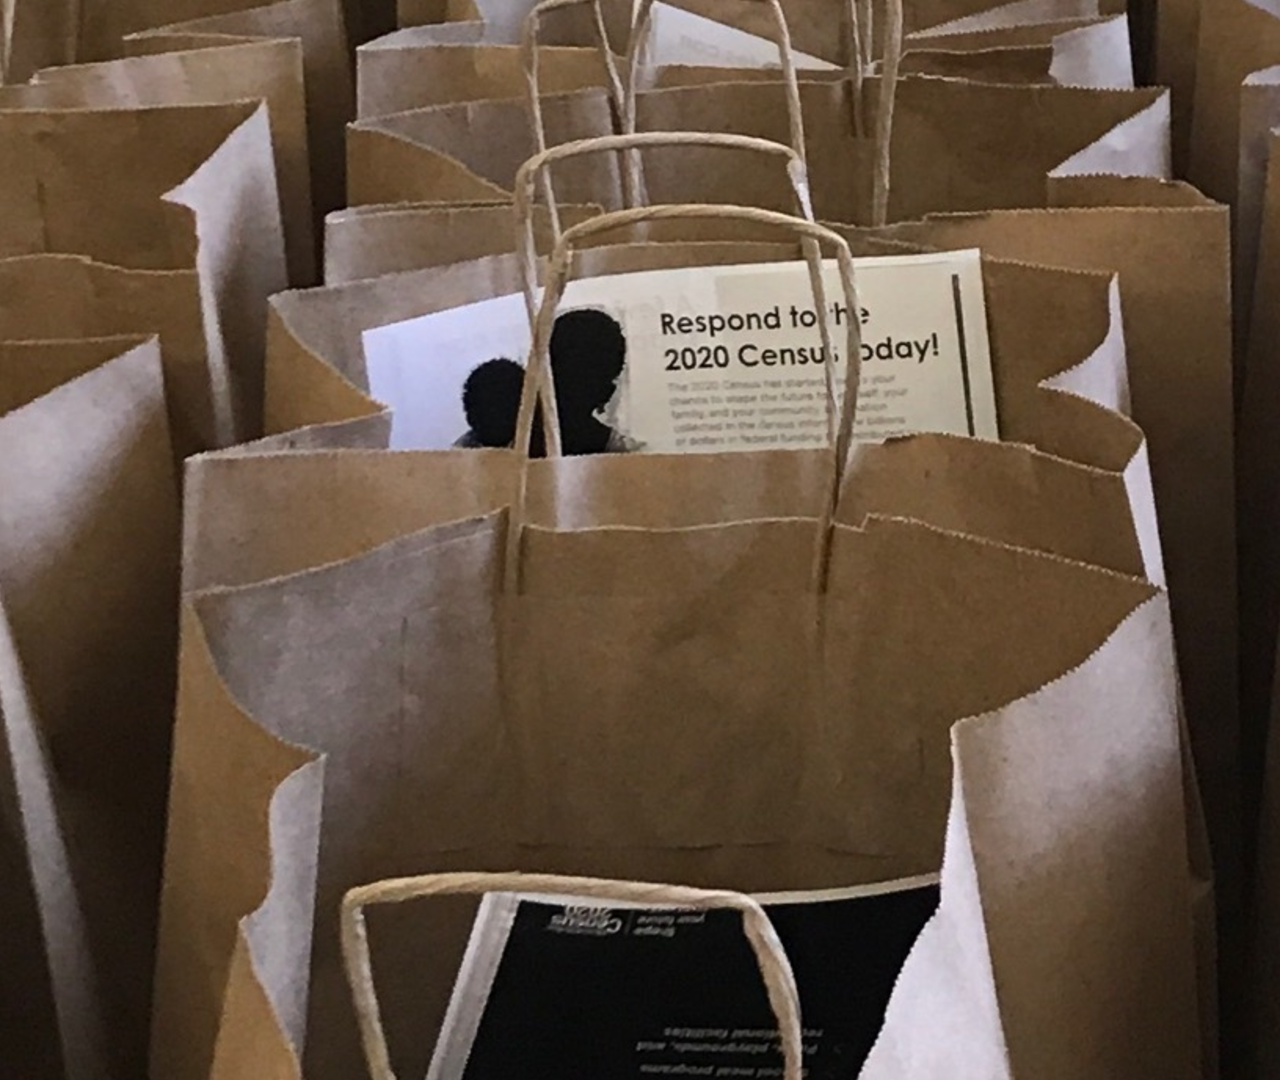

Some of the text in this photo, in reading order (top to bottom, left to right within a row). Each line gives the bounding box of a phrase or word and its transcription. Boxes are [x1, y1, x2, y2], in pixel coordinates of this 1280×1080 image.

[660, 302, 870, 337] Respond to he
[664, 346, 730, 371] 2020
[860, 333, 940, 364] oday!
